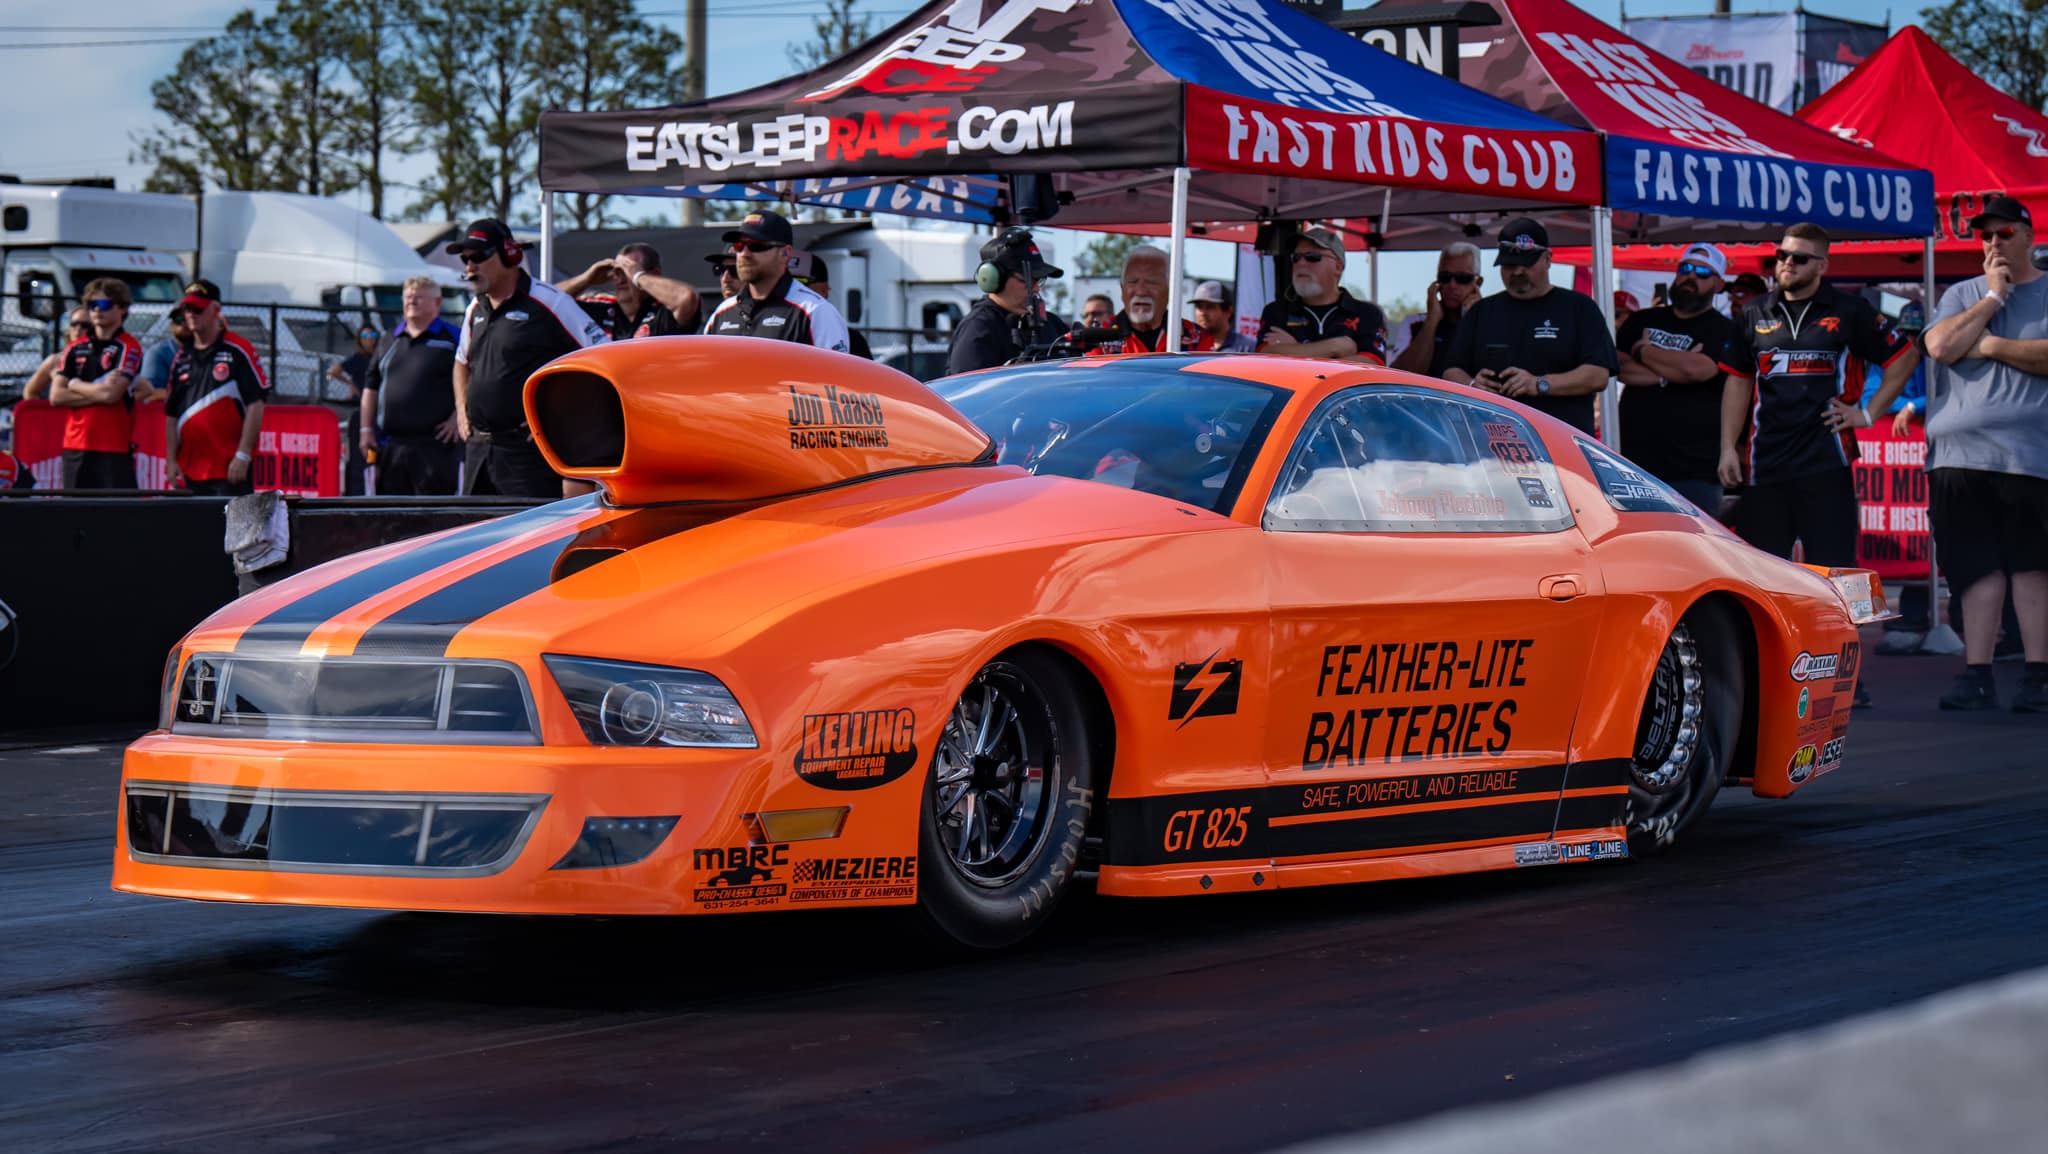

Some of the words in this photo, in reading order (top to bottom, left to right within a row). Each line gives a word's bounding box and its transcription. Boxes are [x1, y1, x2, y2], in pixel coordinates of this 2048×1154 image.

[1197, 32, 1375, 101] KIDS
[1536, 32, 1681, 89] FAST
[1594, 81, 1747, 137] KIDS
[625, 100, 1075, 172] EATSLEEPRACE.COM
[1223, 105, 1335, 170] FAST
[1353, 120, 1448, 181] KIDS
[1463, 134, 1576, 192] CLUB
[1635, 148, 1721, 207] FAST
[1733, 159, 1813, 214] KIDS
[1824, 169, 1914, 223] CLUB
[788, 385, 825, 426] Jon
[824, 385, 884, 426] Kaase
[790, 431, 838, 449] RACING
[840, 430, 889, 448] ENGINES
[1885, 441, 1928, 466] BIGGE
[1860, 505, 1886, 531] THE
[1317, 639, 1535, 697] FEATHER-LITE
[803, 708, 916, 760] KELLING
[1302, 699, 1518, 771] BATTERIES
[800, 758, 853, 774] EQUIPMENT
[853, 755, 887, 769] REPAIR
[1302, 787, 1342, 810] SAFE,
[1347, 780, 1422, 807] POWERFUL
[1426, 776, 1456, 796] AND
[1458, 771, 1518, 794] RELIABLE
[1164, 810, 1205, 853] GT
[1205, 806, 1252, 850] 825
[789, 888, 848, 900] COMPONENTS
[850, 887, 862, 897] OF
[864, 886, 915, 898] CHAMPIONS
[813, 856, 917, 881] MEZIERE
